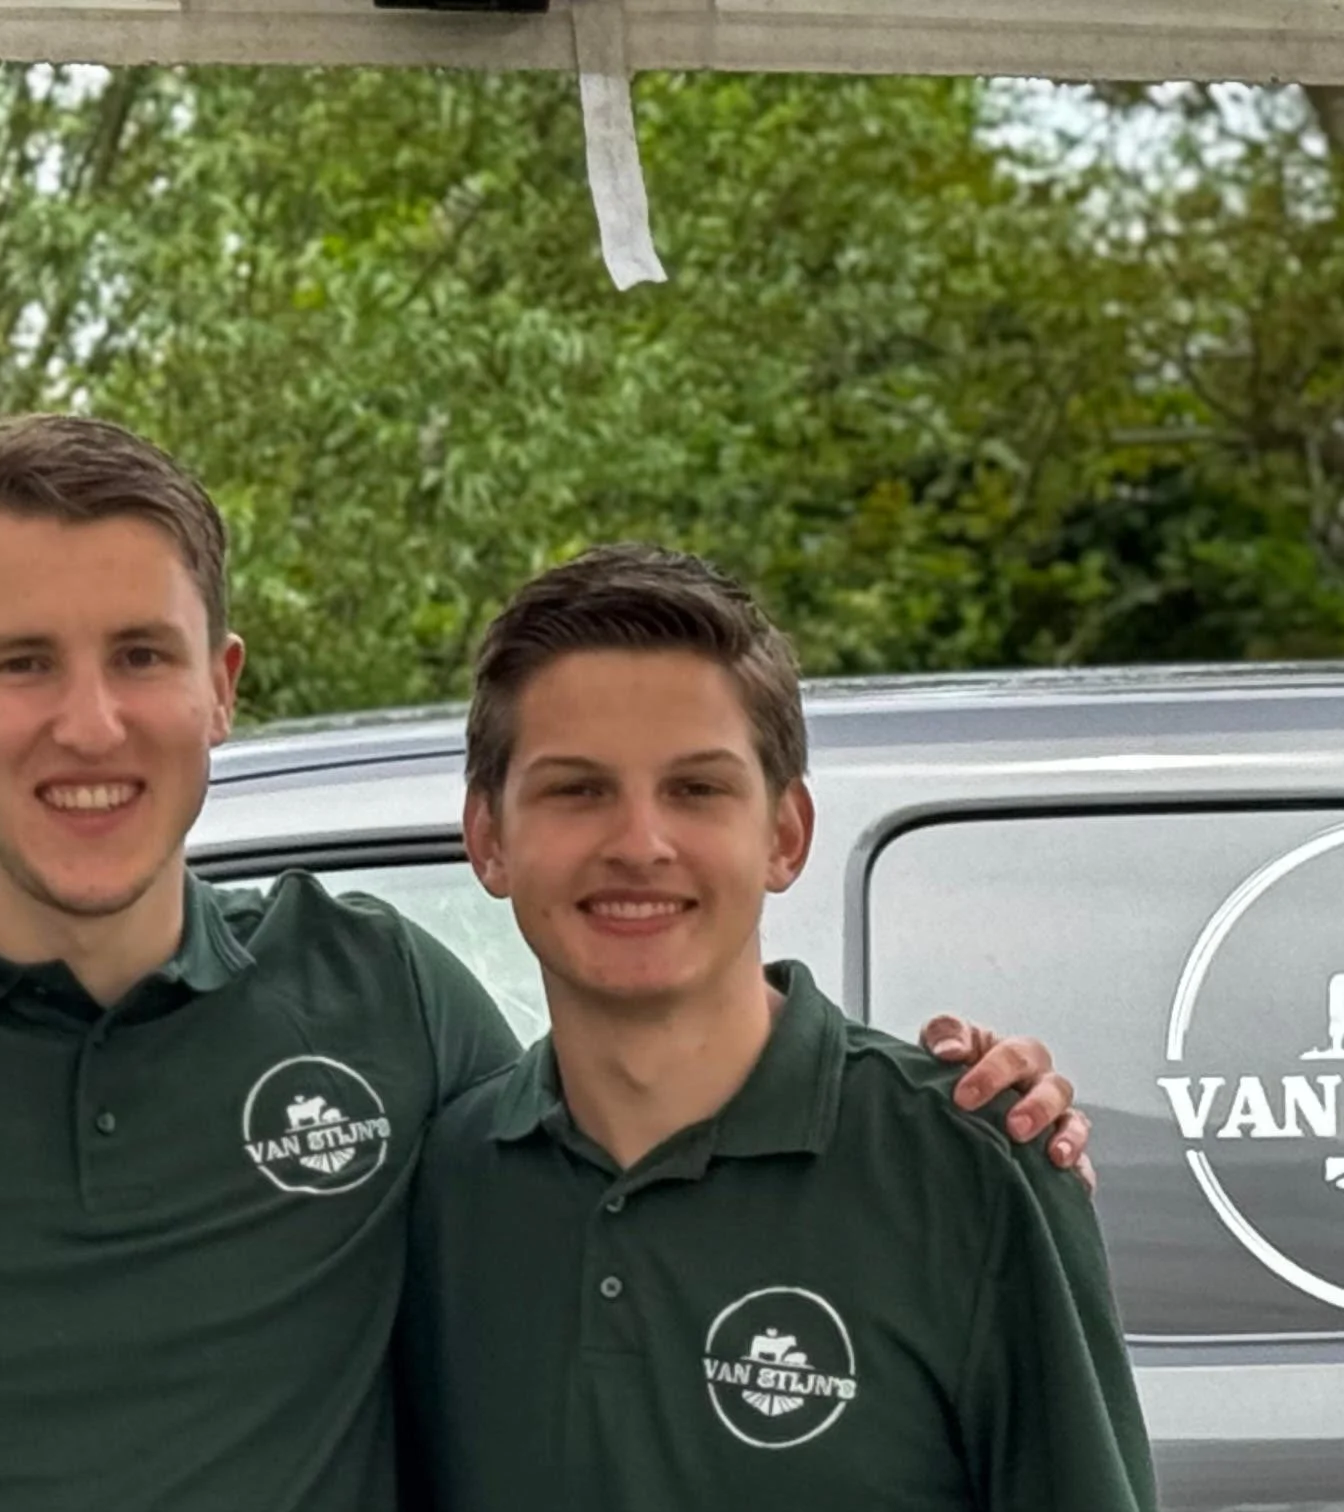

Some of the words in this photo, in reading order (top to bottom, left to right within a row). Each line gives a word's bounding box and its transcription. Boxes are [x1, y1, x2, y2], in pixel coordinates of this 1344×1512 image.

[1157, 1073, 1342, 1138] VAN
[244, 1134, 301, 1163] VAN
[307, 1116, 392, 1151] STIJN'S
[703, 1357, 752, 1385] VAN
[757, 1368, 857, 1399] STIJN'S
